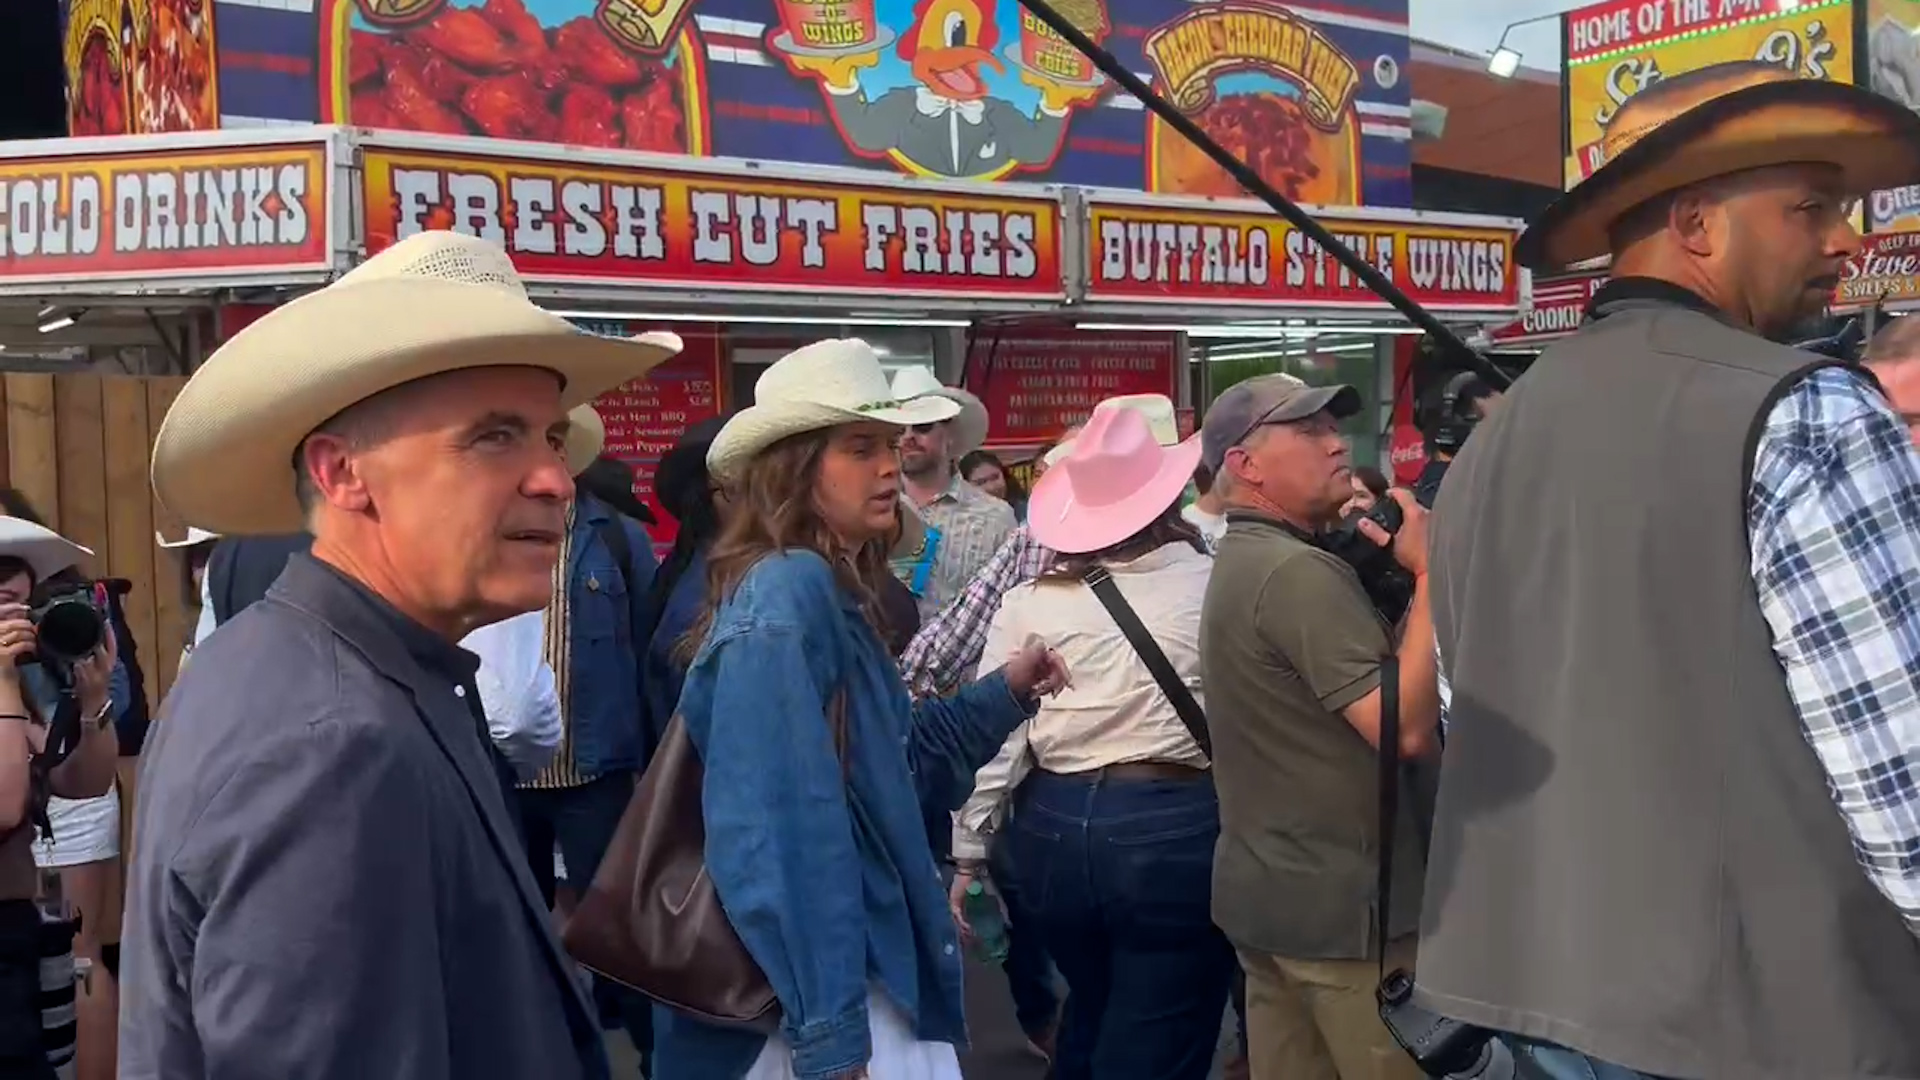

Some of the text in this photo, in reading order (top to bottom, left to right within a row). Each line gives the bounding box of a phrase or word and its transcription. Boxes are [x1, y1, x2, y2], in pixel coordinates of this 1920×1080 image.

[801, 21, 864, 43] WINGS
[1155, 19, 1214, 92] BACON
[1220, 13, 1306, 74] CHEDDAR
[1572, 15, 1631, 51] HOME
[1637, 0, 1665, 34] OF
[1671, 0, 1711, 27] THE
[0, 164, 307, 256] OLD DRINKS
[393, 169, 1037, 279] FRESH CUT FRIES
[1100, 218, 1270, 286] BUFFALO
[1407, 236, 1504, 292] WINGS
